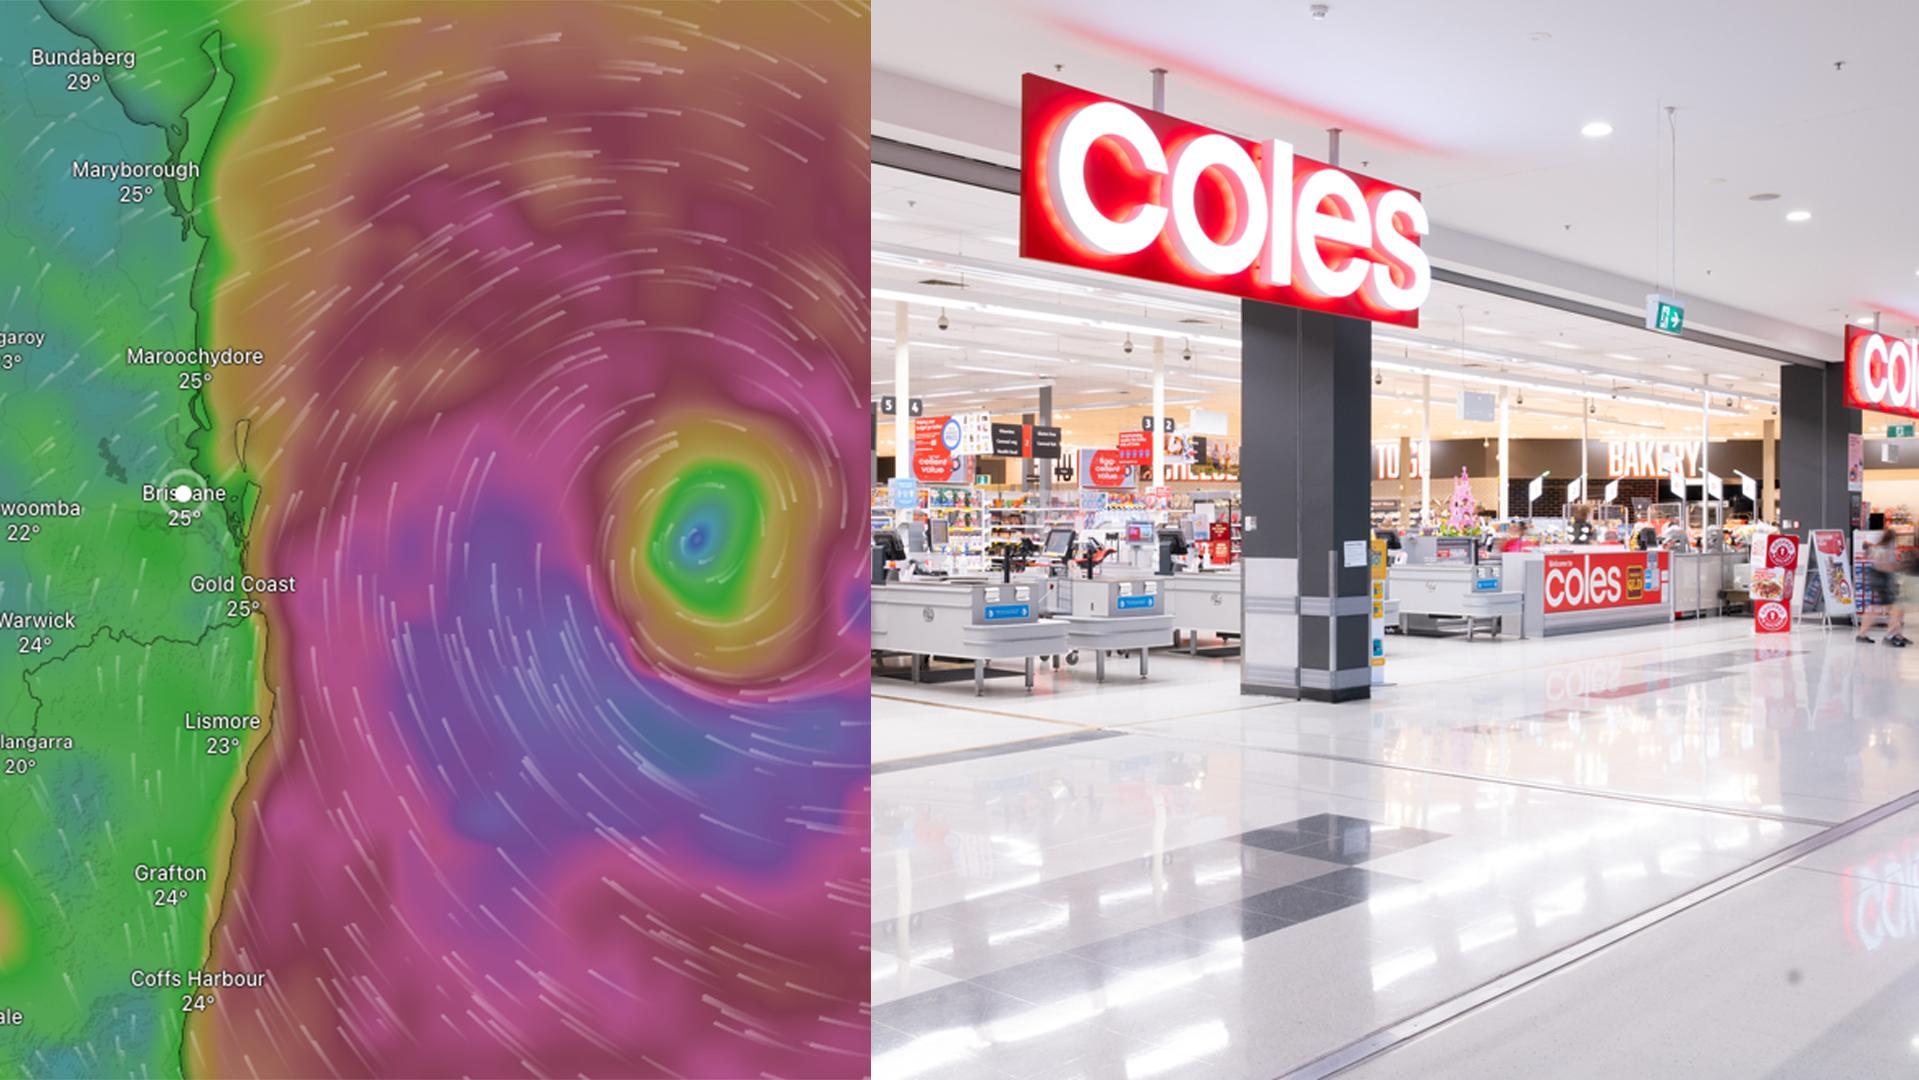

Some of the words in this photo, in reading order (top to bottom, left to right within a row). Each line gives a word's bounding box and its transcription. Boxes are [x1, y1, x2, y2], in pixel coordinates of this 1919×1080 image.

[1050, 101, 1431, 311] coles
[1862, 333, 1919, 408] col
[884, 399, 893, 411] 5
[911, 402, 919, 414] 4
[1145, 419, 1152, 429] 3
[1166, 420, 1173, 431] 2
[1375, 443, 1400, 479] TO
[1608, 441, 1702, 479] BAKERY
[1545, 554, 1622, 608] coles
